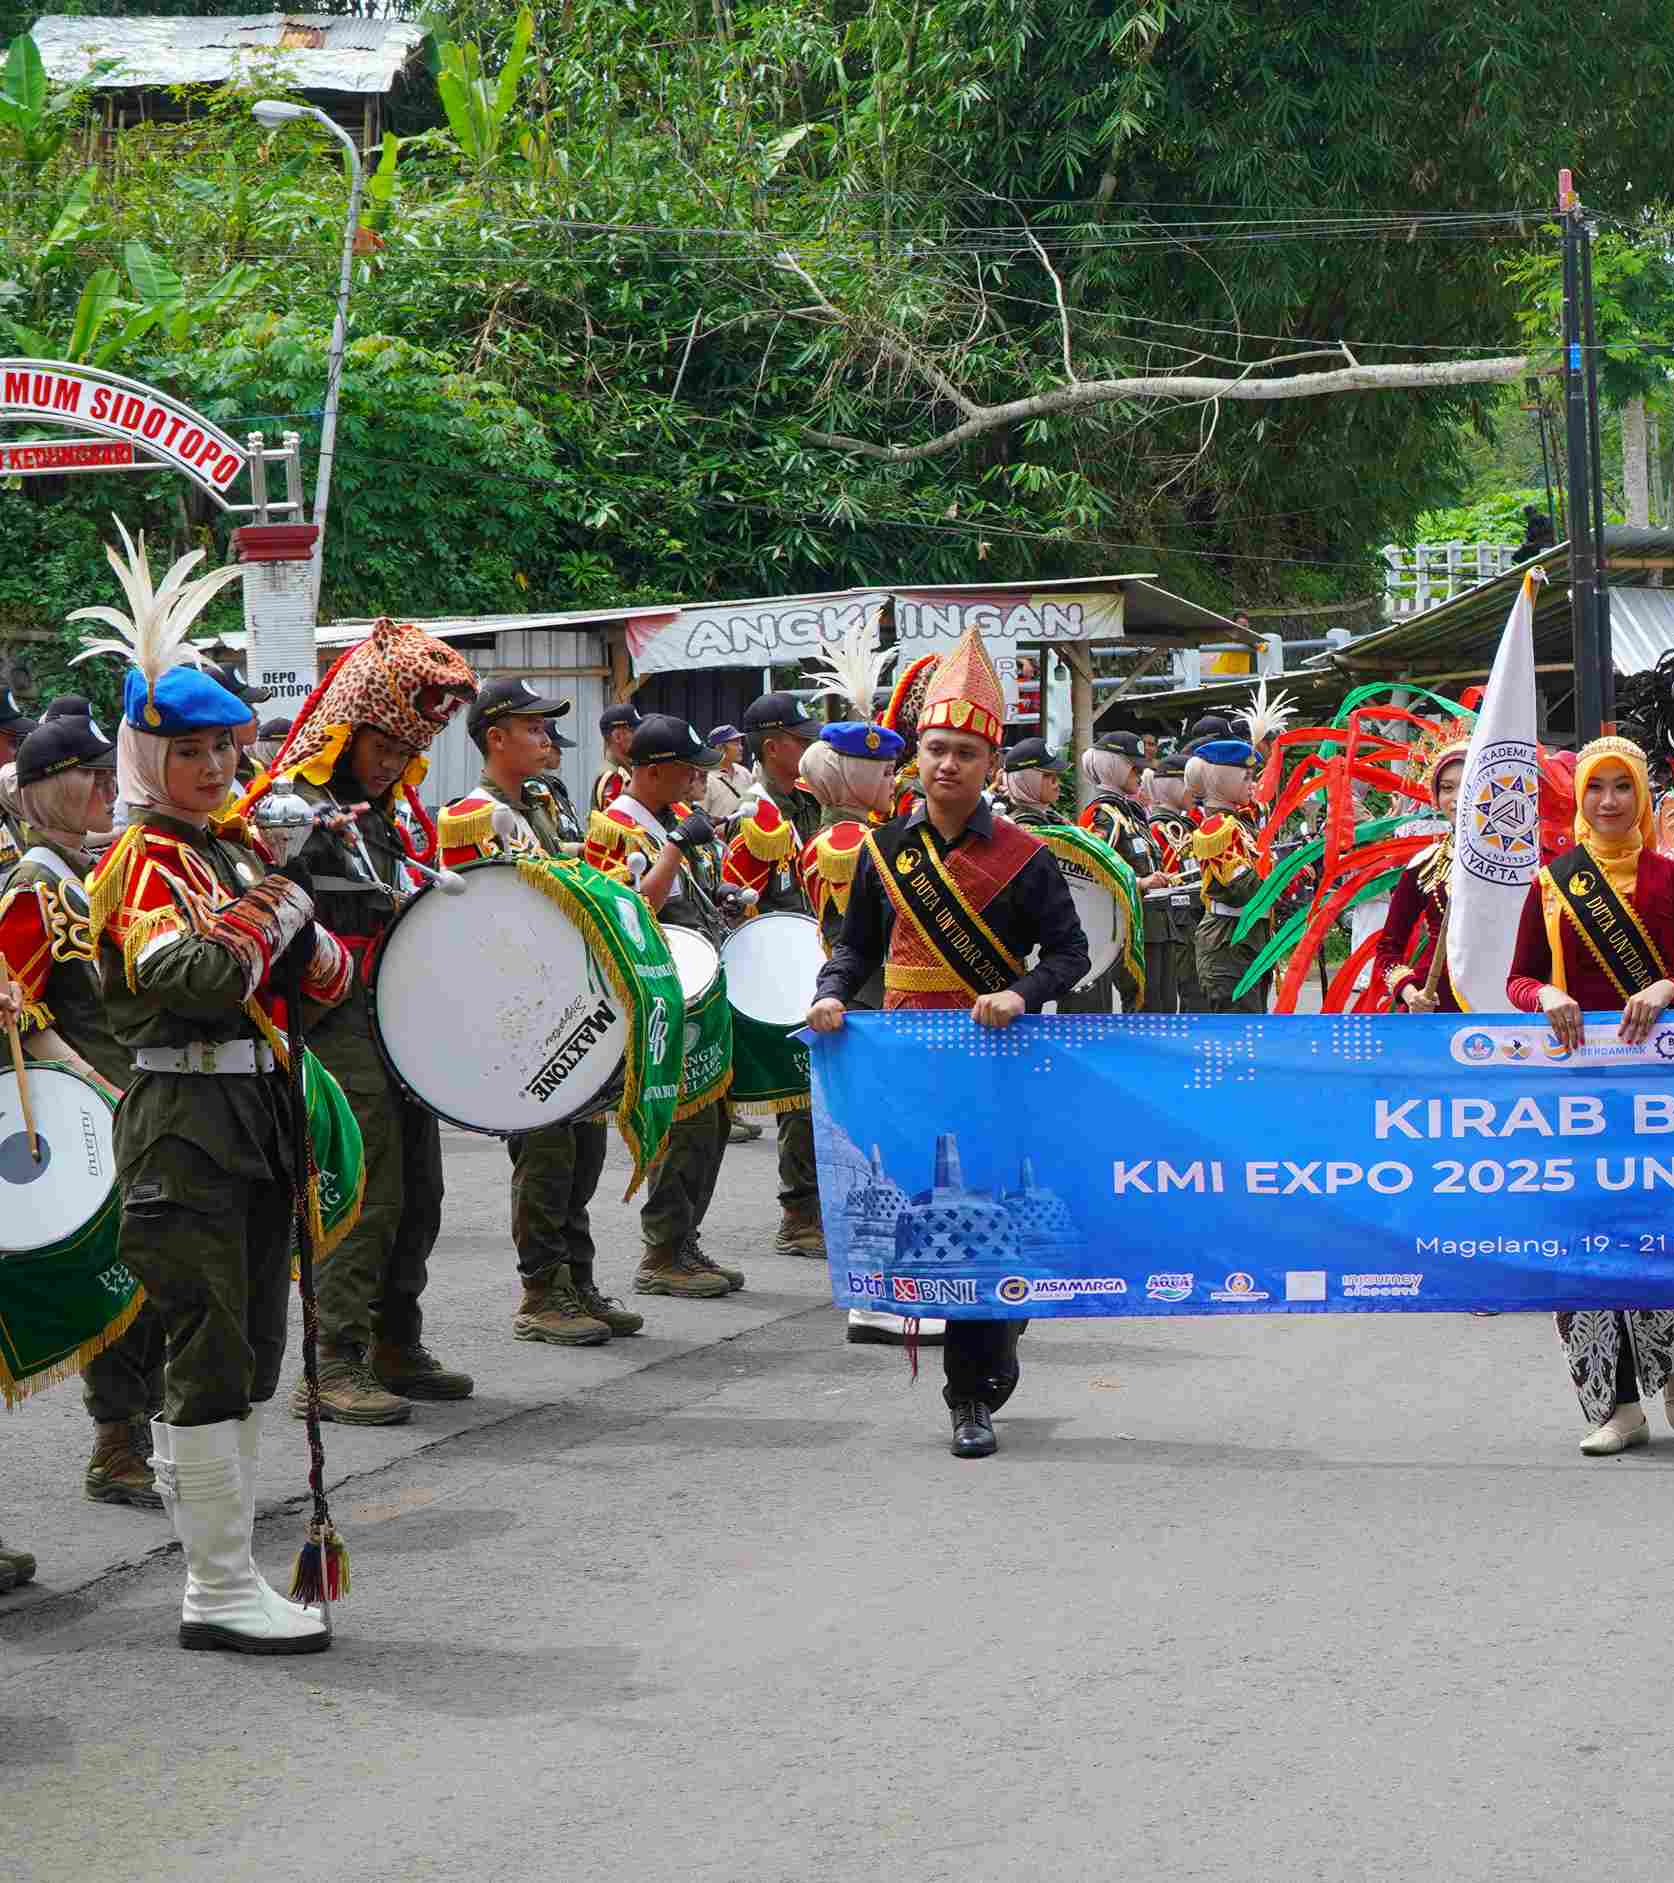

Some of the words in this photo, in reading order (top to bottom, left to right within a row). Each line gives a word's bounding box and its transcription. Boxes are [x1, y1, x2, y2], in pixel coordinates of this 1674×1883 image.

[89, 388, 240, 484] SIDOTOPO
[261, 684, 313, 698] OTOPO
[263, 672, 296, 684] DEPO
[911, 872, 937, 912] DUTA
[935, 906, 982, 967] UNTIDAR
[975, 959, 1008, 993] 2025
[1585, 895, 1616, 934] DUTA
[529, 999, 617, 1104] MAXTONE
[1375, 1095, 1608, 1140] KIRAB
[1113, 1160, 1225, 1195] KMI
[1246, 1160, 1413, 1195] EXPO
[1432, 1158, 1576, 1194] 2025
[1416, 1235, 1568, 1258] Magelang,
[1583, 1234, 1609, 1252] 19
[1640, 1234, 1667, 1252] 21
[919, 1279, 977, 1303] BNI
[1149, 1274, 1192, 1287] AQUA
